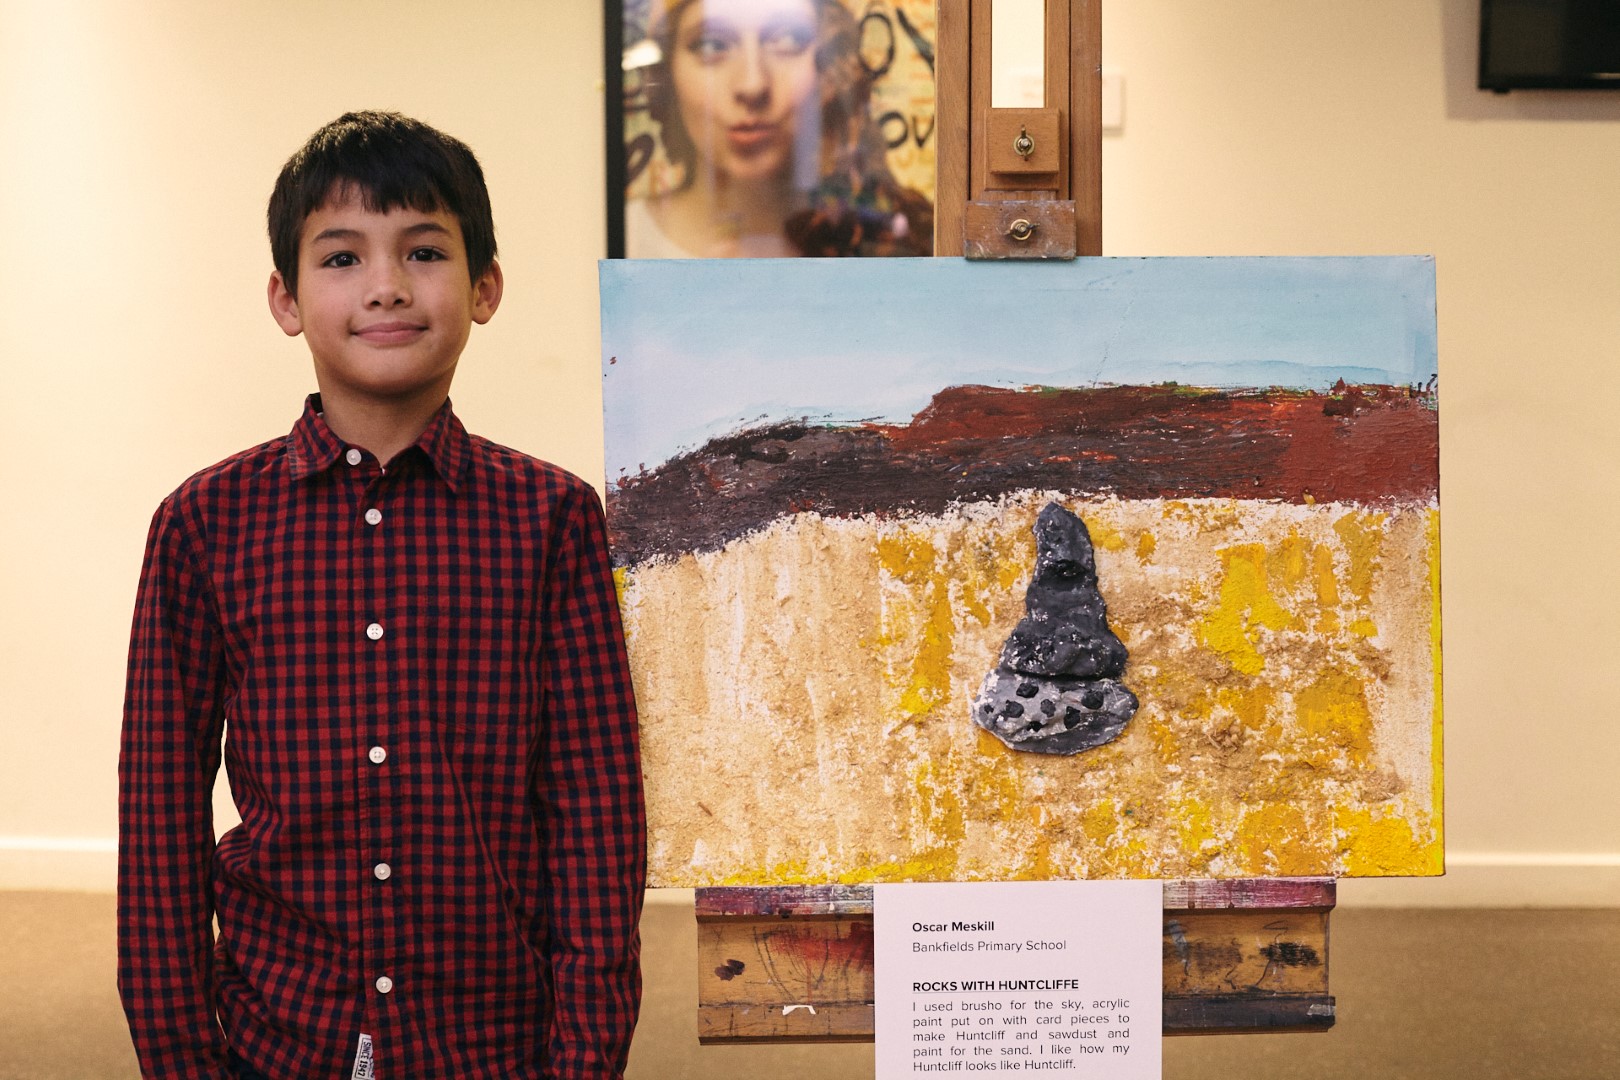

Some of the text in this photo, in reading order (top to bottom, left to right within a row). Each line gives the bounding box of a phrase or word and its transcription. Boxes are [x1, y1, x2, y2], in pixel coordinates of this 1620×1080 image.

[912, 921, 994, 932] Oscar Meskill
[913, 940, 1066, 952] Bankfields Primary School
[913, 979, 1079, 992] ROCKS WITH HUNTCLIFFE
[913, 998, 1130, 1012] I used brusho for the sky, acrylic
[913, 1017, 942, 1028] paint
[951, 1017, 970, 1028] put
[1003, 1015, 1026, 1025] with
[1036, 1014, 1061, 1024] card
[1071, 1014, 1109, 1026] pieces
[1118, 1014, 1130, 1023] to
[913, 1028, 1129, 1041] make Huntcliff and sawdust and
[913, 1044, 1130, 1058] paint for the sand. I like how my
[358, 1042, 371, 1077] SINCE 1947
[913, 1059, 1076, 1071] Huntcliff looks like Huntcliff.
